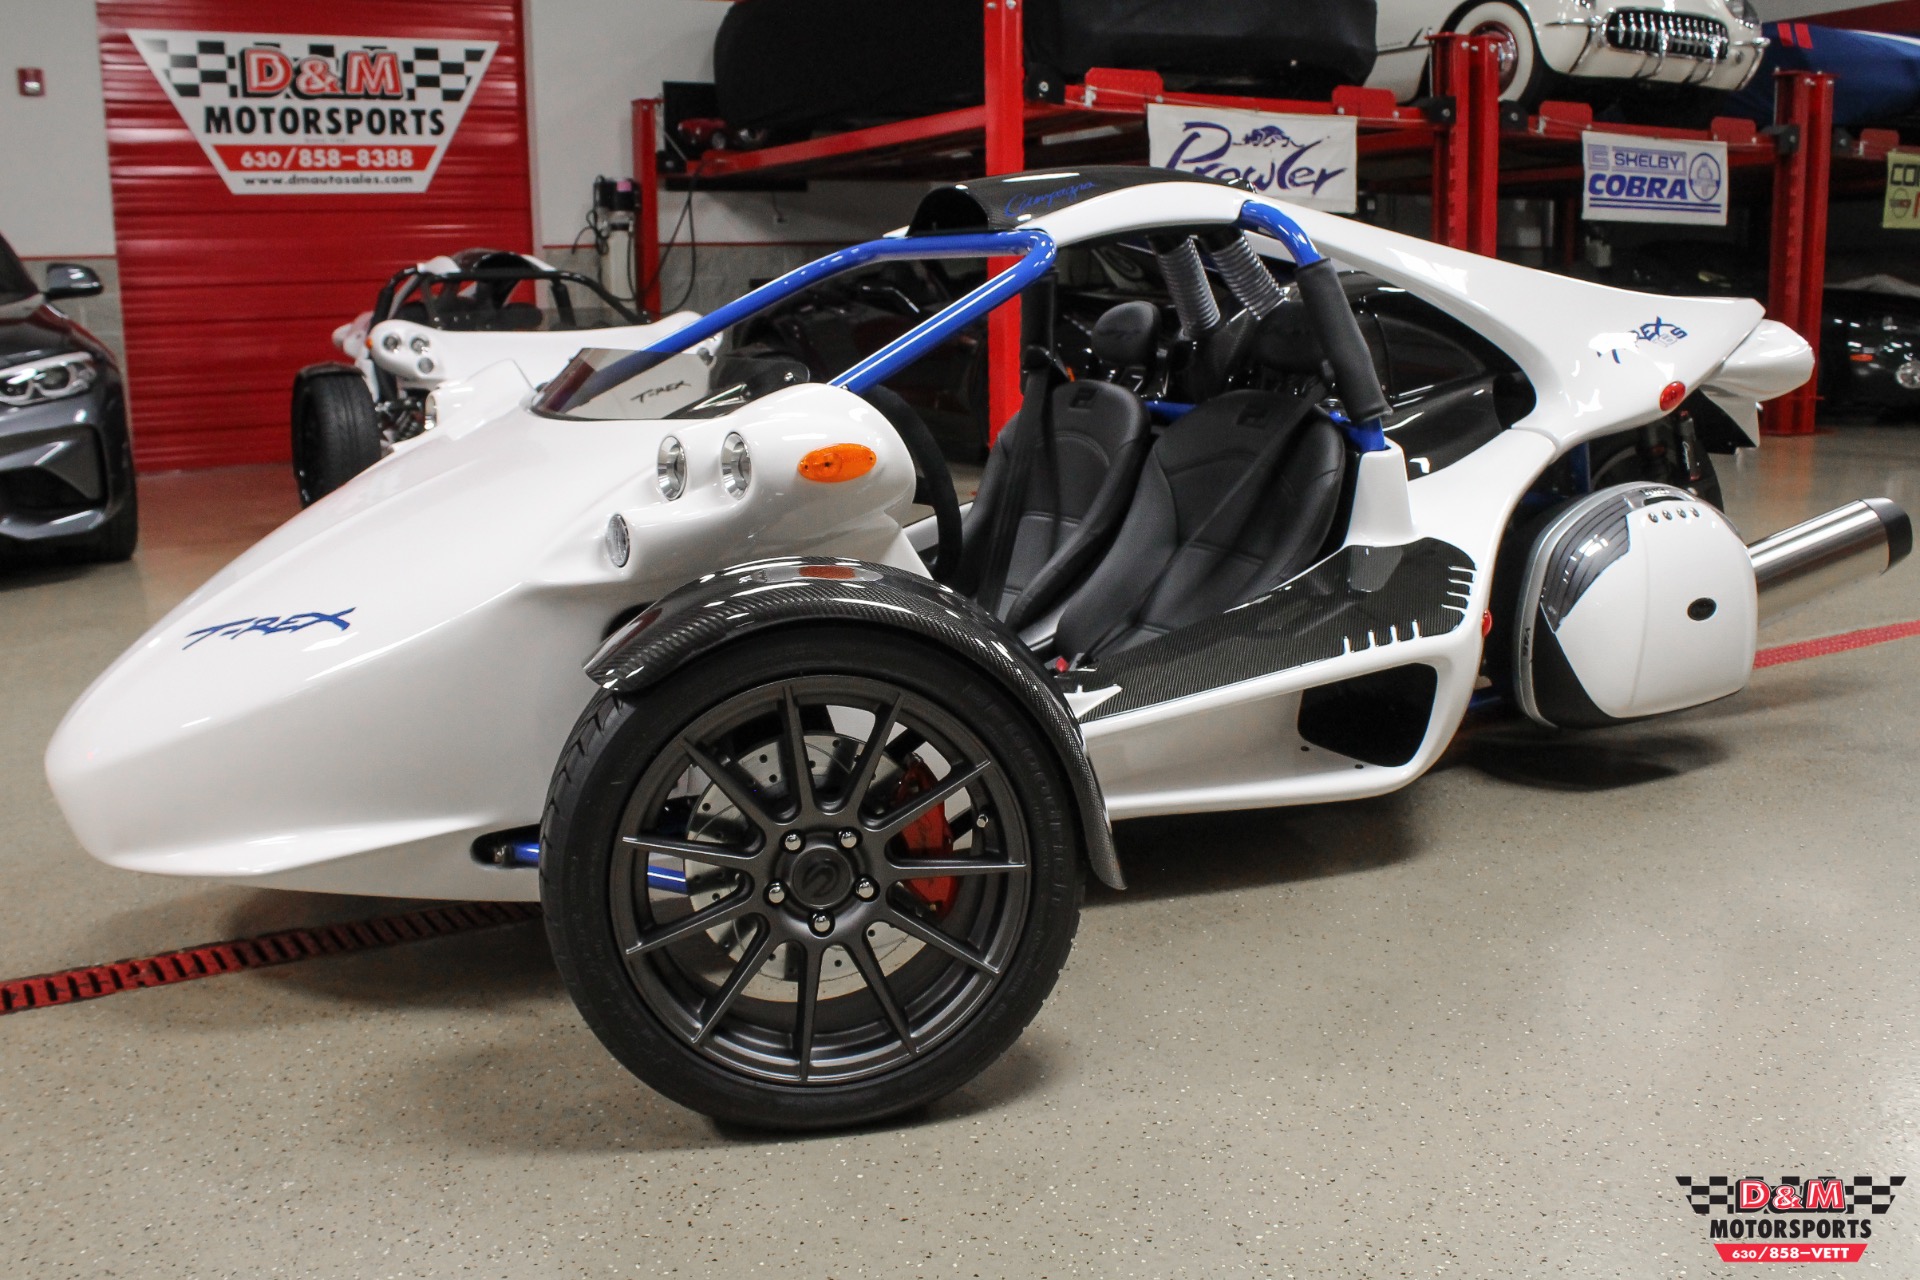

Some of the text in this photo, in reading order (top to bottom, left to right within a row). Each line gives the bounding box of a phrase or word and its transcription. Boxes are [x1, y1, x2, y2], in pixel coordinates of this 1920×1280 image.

[241, 48, 404, 99] D&M
[204, 106, 446, 136] MOTORSPORTS
[240, 146, 414, 169] 630/858-8388
[1165, 121, 1349, 195] Prowler
[1614, 151, 1681, 170] SHELBY
[243, 173, 414, 186] www.dmautosales.com
[1588, 172, 1688, 200] COBRA
[1890, 163, 1920, 187] CO
[1004, 181, 1099, 217] Campagna
[181, 606, 357, 651] T-REX
